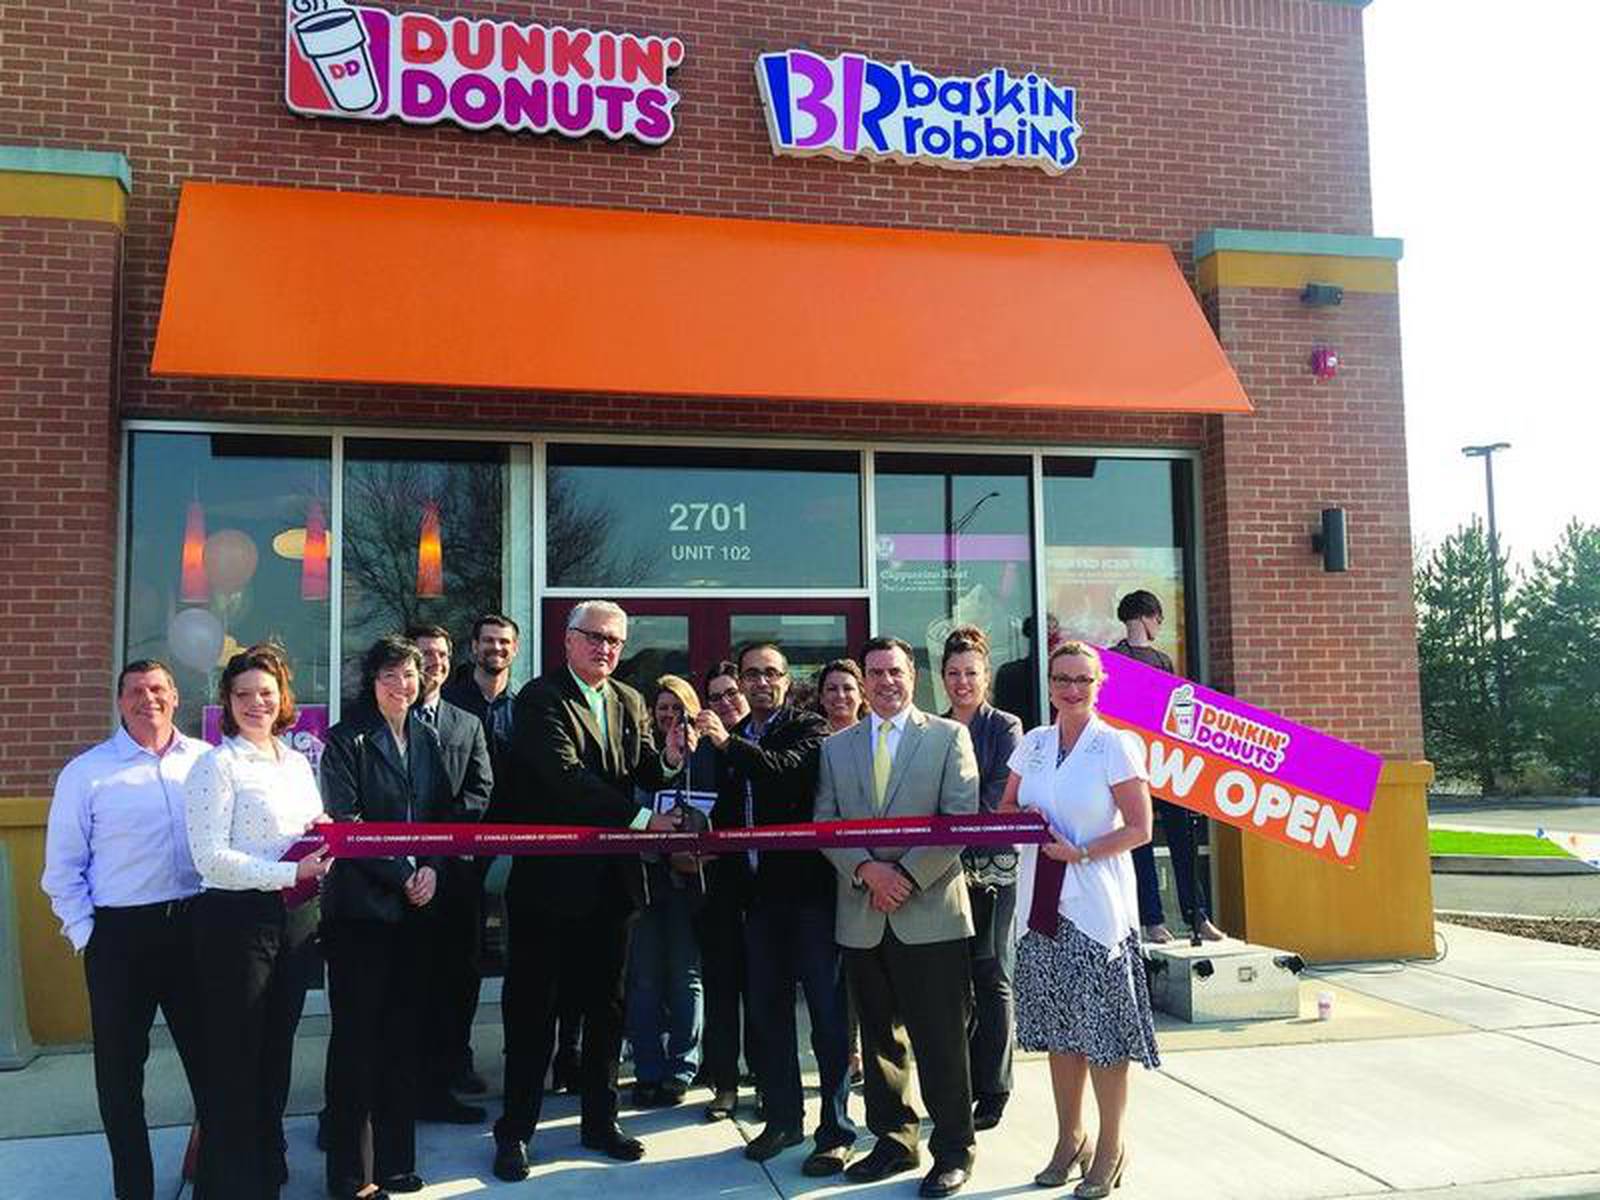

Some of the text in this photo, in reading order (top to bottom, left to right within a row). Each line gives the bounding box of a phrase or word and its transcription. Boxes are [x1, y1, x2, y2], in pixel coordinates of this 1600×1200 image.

[328, 60, 360, 80] DD
[402, 16, 683, 85] DUNKIN'
[402, 69, 672, 139] DONUTS
[669, 502, 747, 531] 2701
[671, 545, 751, 560] UNIT 102
[1196, 726, 1277, 770] DONUTS
[1202, 706, 1288, 750] DUNKIN'
[1214, 770, 1358, 858] OPEN
